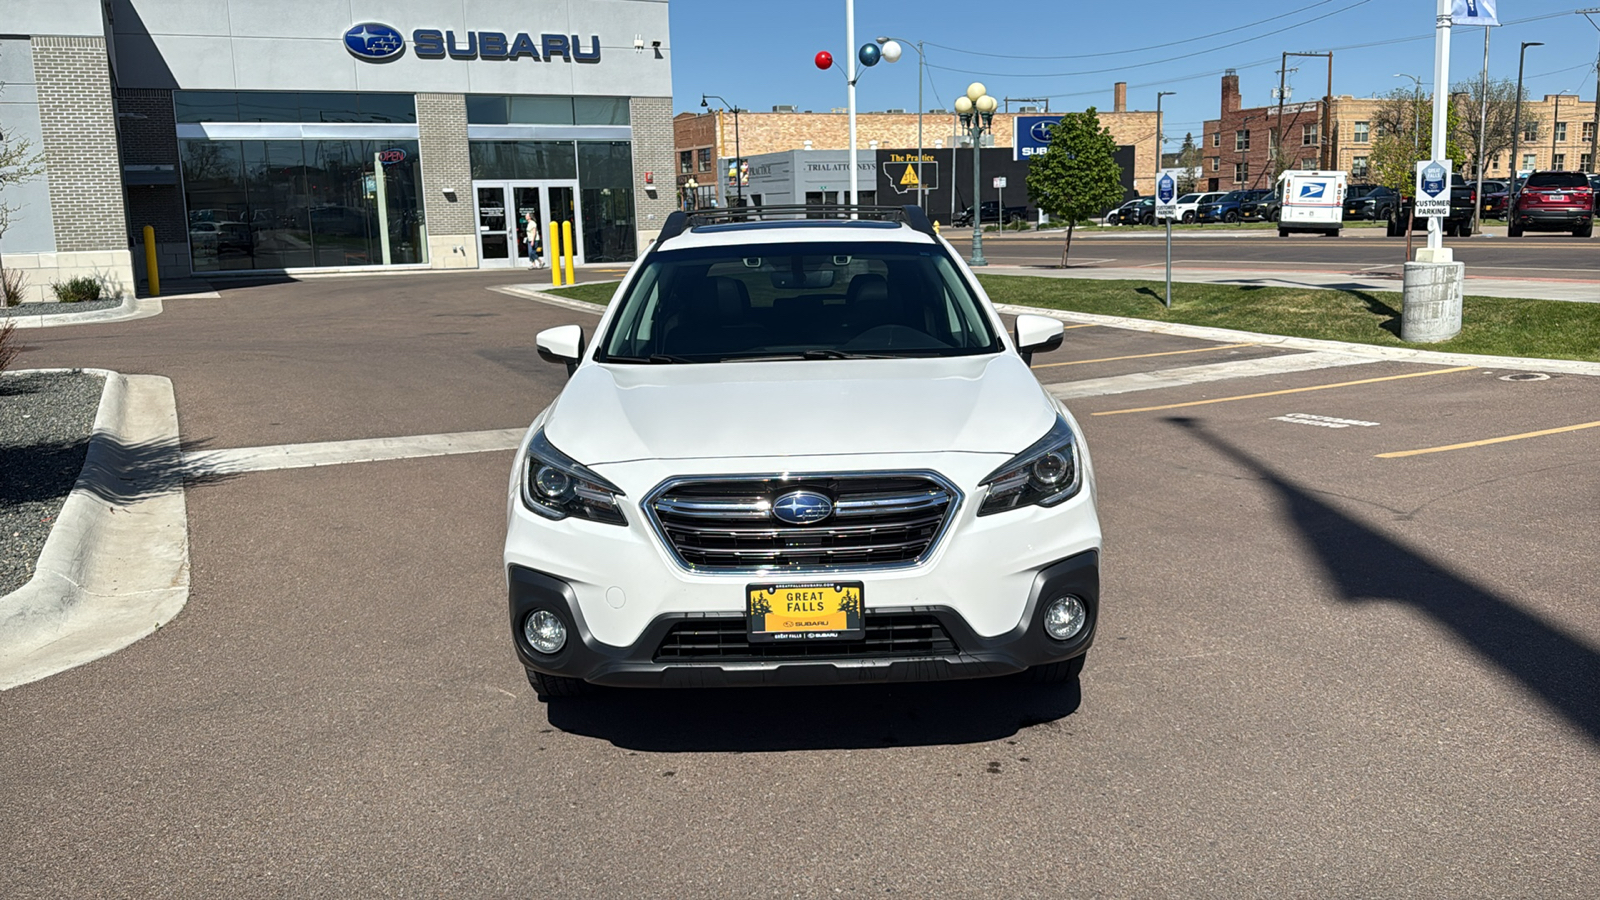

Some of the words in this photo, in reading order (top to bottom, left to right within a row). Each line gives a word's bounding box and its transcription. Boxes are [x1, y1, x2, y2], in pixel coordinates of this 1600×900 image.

[413, 29, 600, 62] SUBARU
[379, 151, 404, 161] OPEN
[890, 154, 905, 162] The
[906, 153, 934, 162] Pratice
[807, 163, 832, 171] TRIAL
[832, 163, 876, 171] ATTONEYS
[787, 592, 823, 601] GREAT
[788, 602, 824, 611] FALLS
